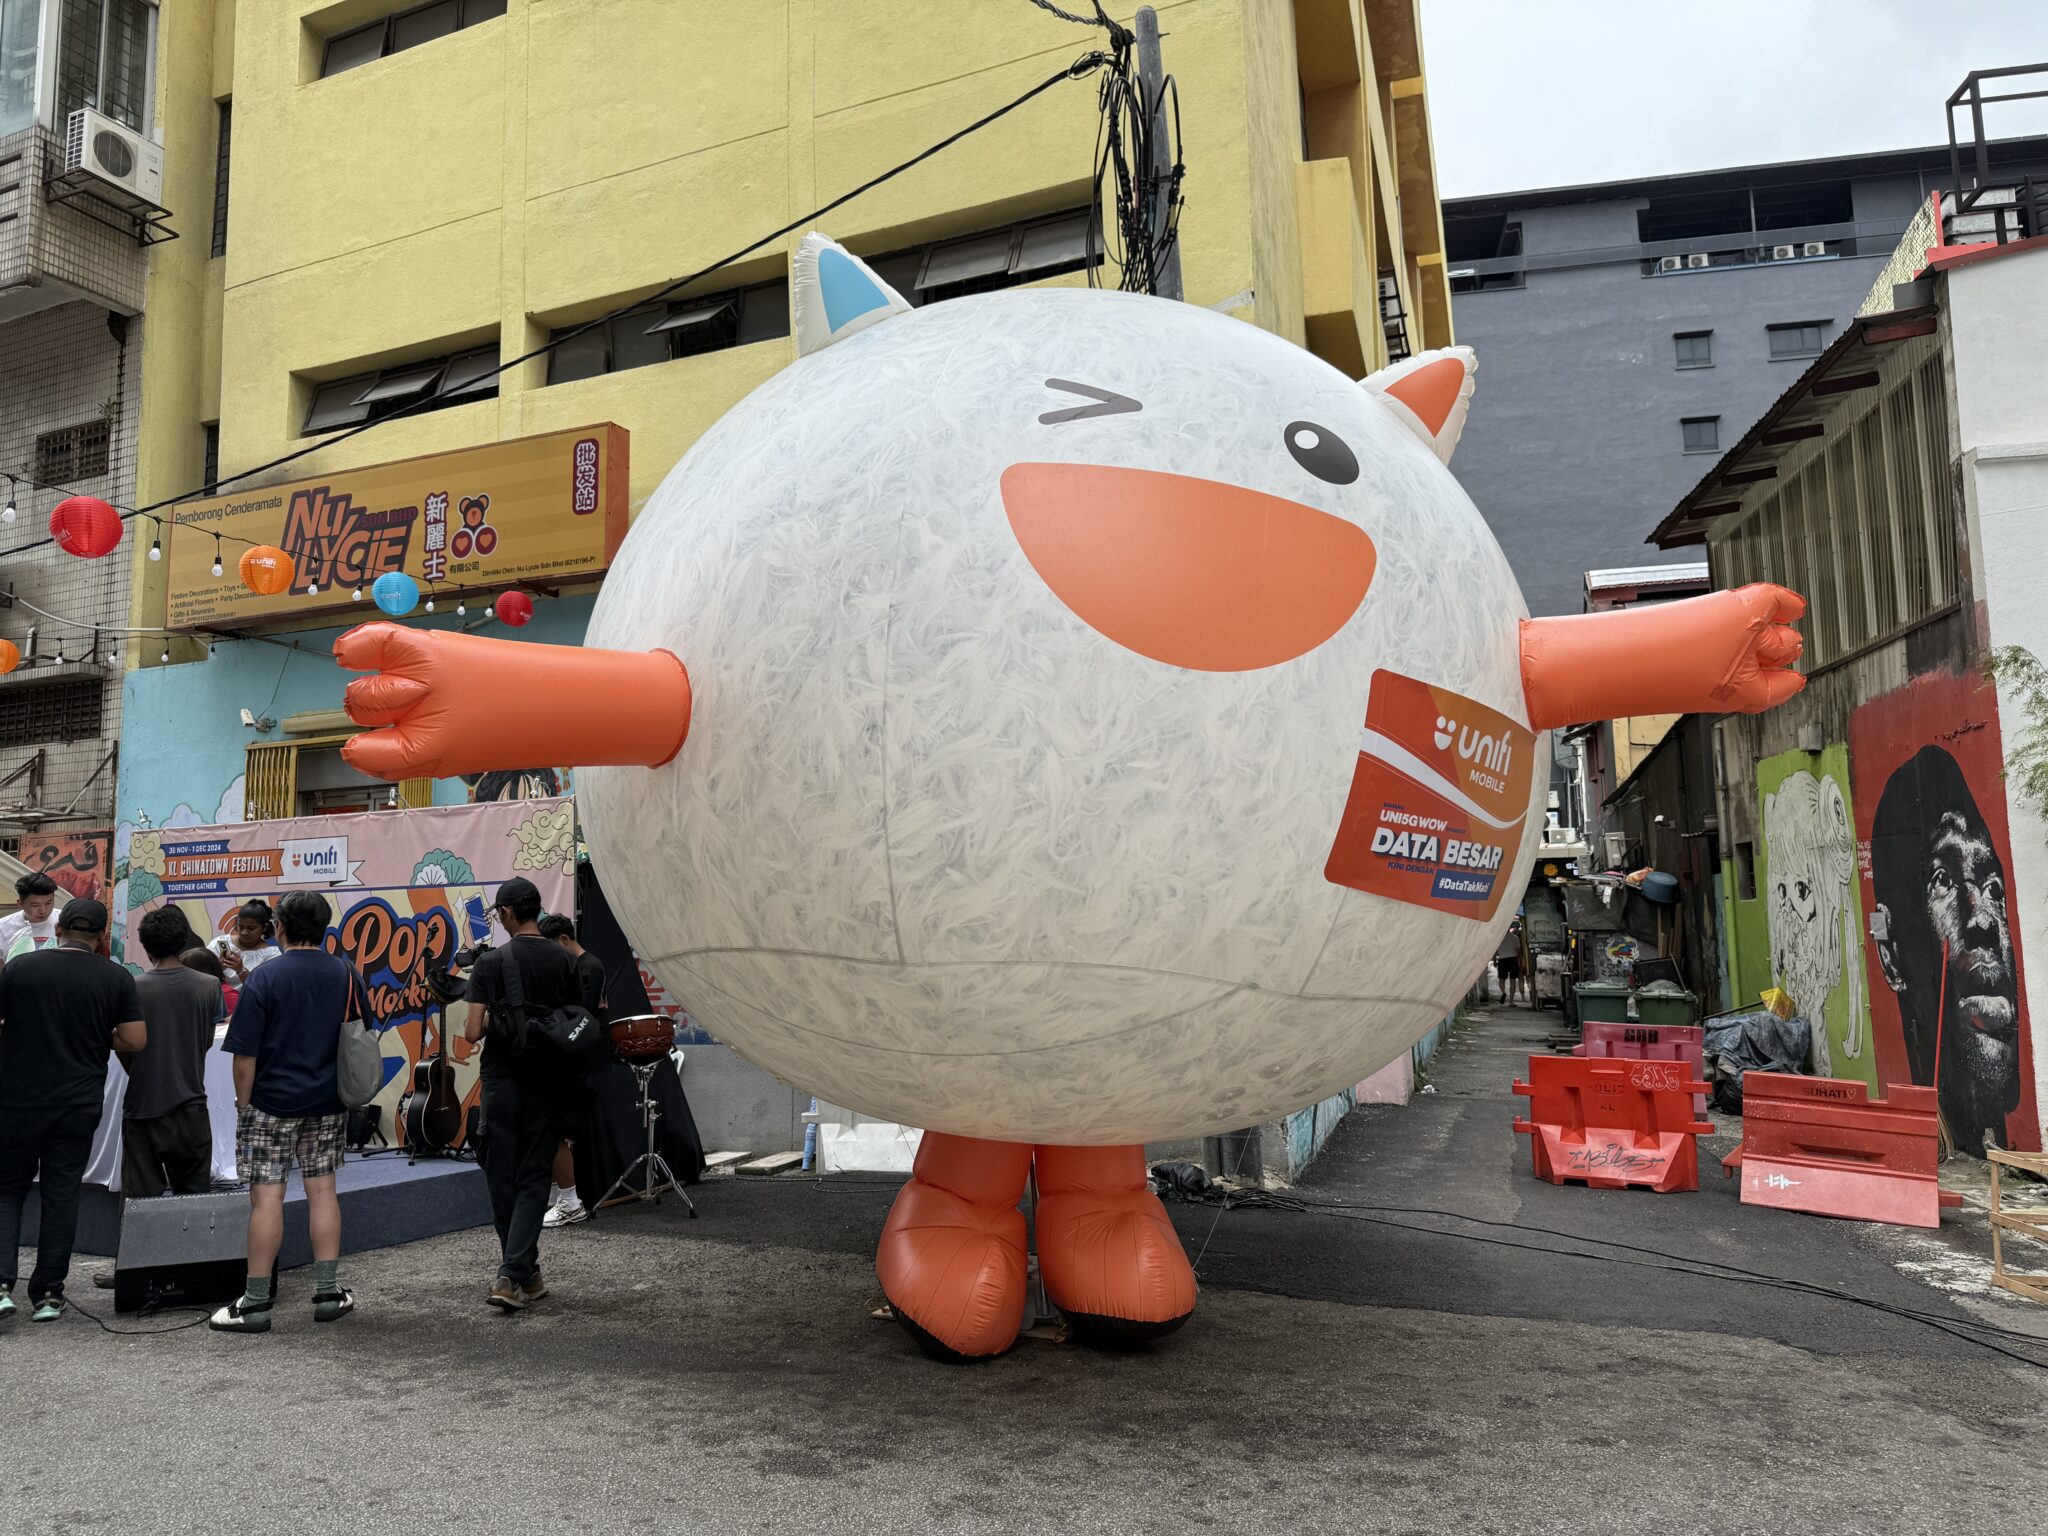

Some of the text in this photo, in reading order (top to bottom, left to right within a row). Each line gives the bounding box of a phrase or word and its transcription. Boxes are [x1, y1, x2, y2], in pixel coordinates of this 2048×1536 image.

[575, 442, 597, 512] 批发站
[175, 496, 283, 525] Pemborong Cenderamata
[425, 492, 448, 580] 新麗士
[449, 561, 480, 574] 有限公司
[170, 592, 189, 600] Festive
[189, 587, 219, 597] Decorations
[174, 600, 194, 609] Artificial
[194, 598, 215, 606] Flowers
[173, 610, 185, 619] Gifts
[1458, 724, 1512, 776] unifi
[1469, 769, 1506, 794] MOBILE
[1420, 816, 1449, 831] WOW
[168, 846, 177, 854] 30
[176, 845, 188, 854] NOV
[195, 845, 206, 853] DEC
[207, 844, 221, 852] 2024
[303, 845, 338, 867] unifi
[1370, 826, 1503, 870] DATA BESAR
[168, 855, 271, 876] KL CHINATOWN FESTIVAL
[1387, 861, 1434, 875] KINI DENGAN
[168, 882, 217, 892] TOGETHER GATHER
[341, 904, 447, 981] Pop
